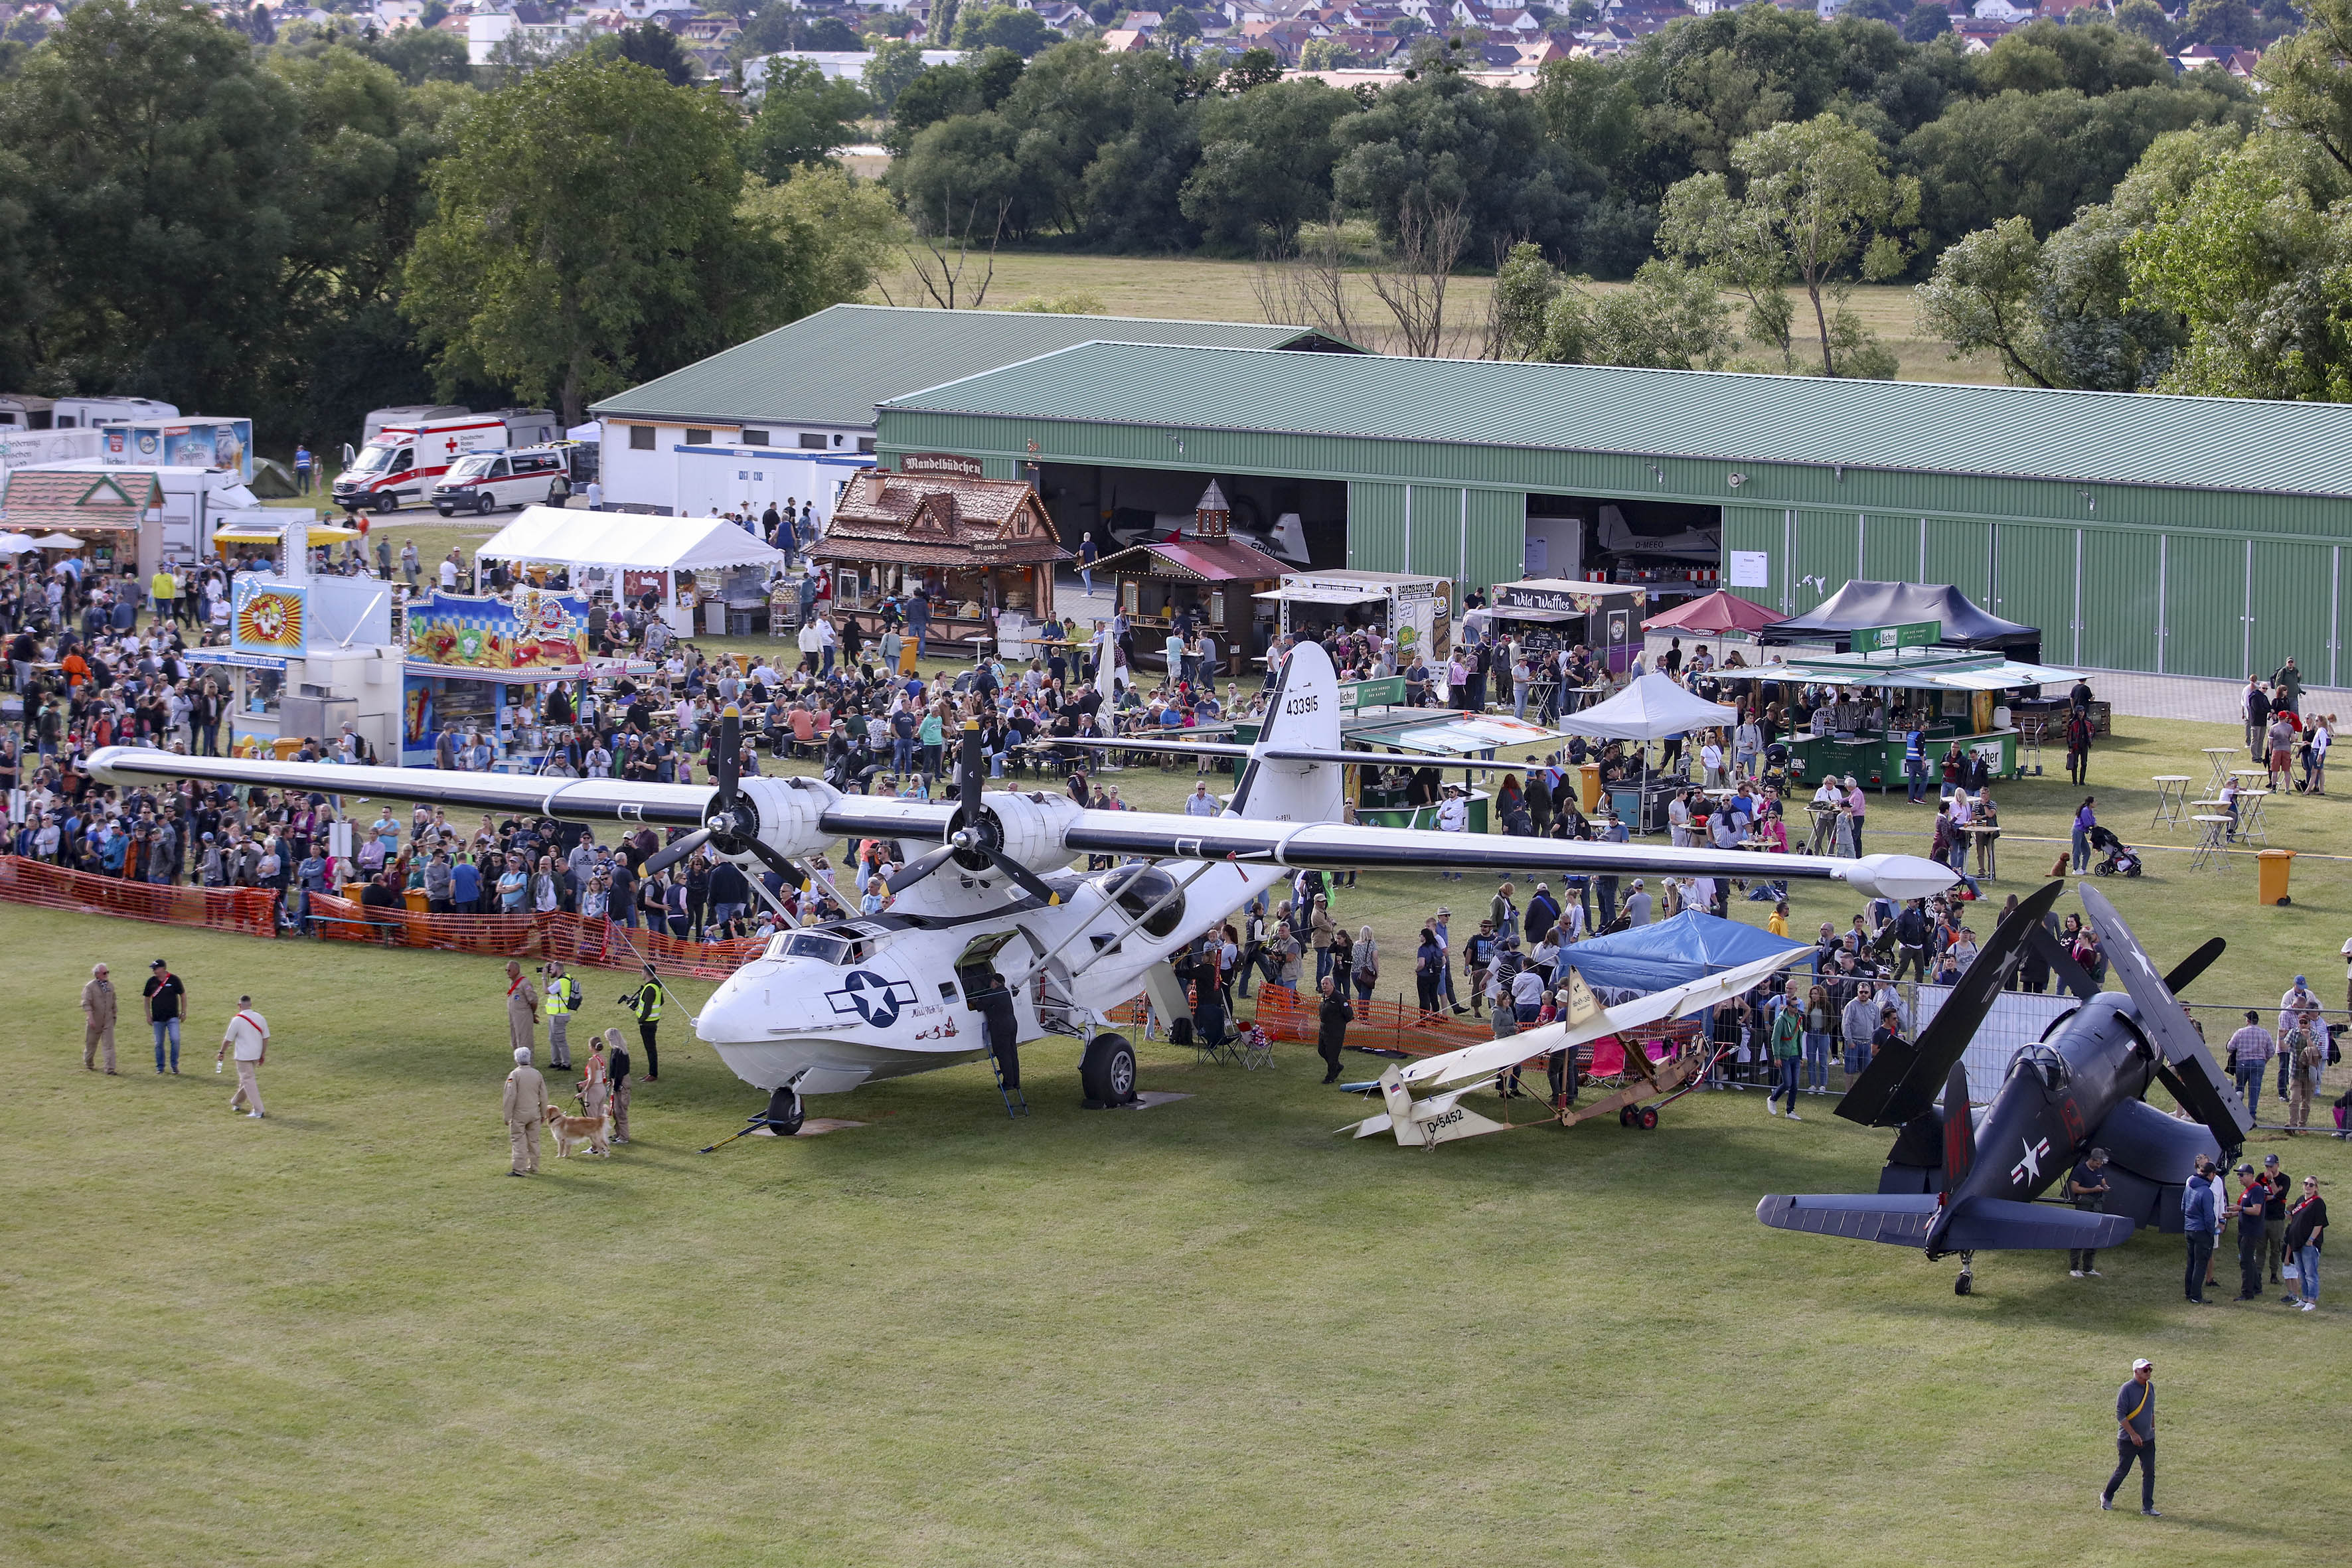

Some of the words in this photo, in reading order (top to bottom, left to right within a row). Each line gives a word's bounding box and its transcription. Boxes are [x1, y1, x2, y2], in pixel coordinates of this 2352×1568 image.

[906, 457, 980, 475] Mandelbüdchen
[974, 542, 1007, 551] Mandeln
[1398, 583, 1434, 595] ROADRUNNER
[1510, 591, 1533, 607] Wild
[1534, 593, 1570, 611] Waffles
[1882, 633, 1896, 644] Licher
[1340, 692, 1356, 704] Licher
[1287, 695, 1318, 716] 433915
